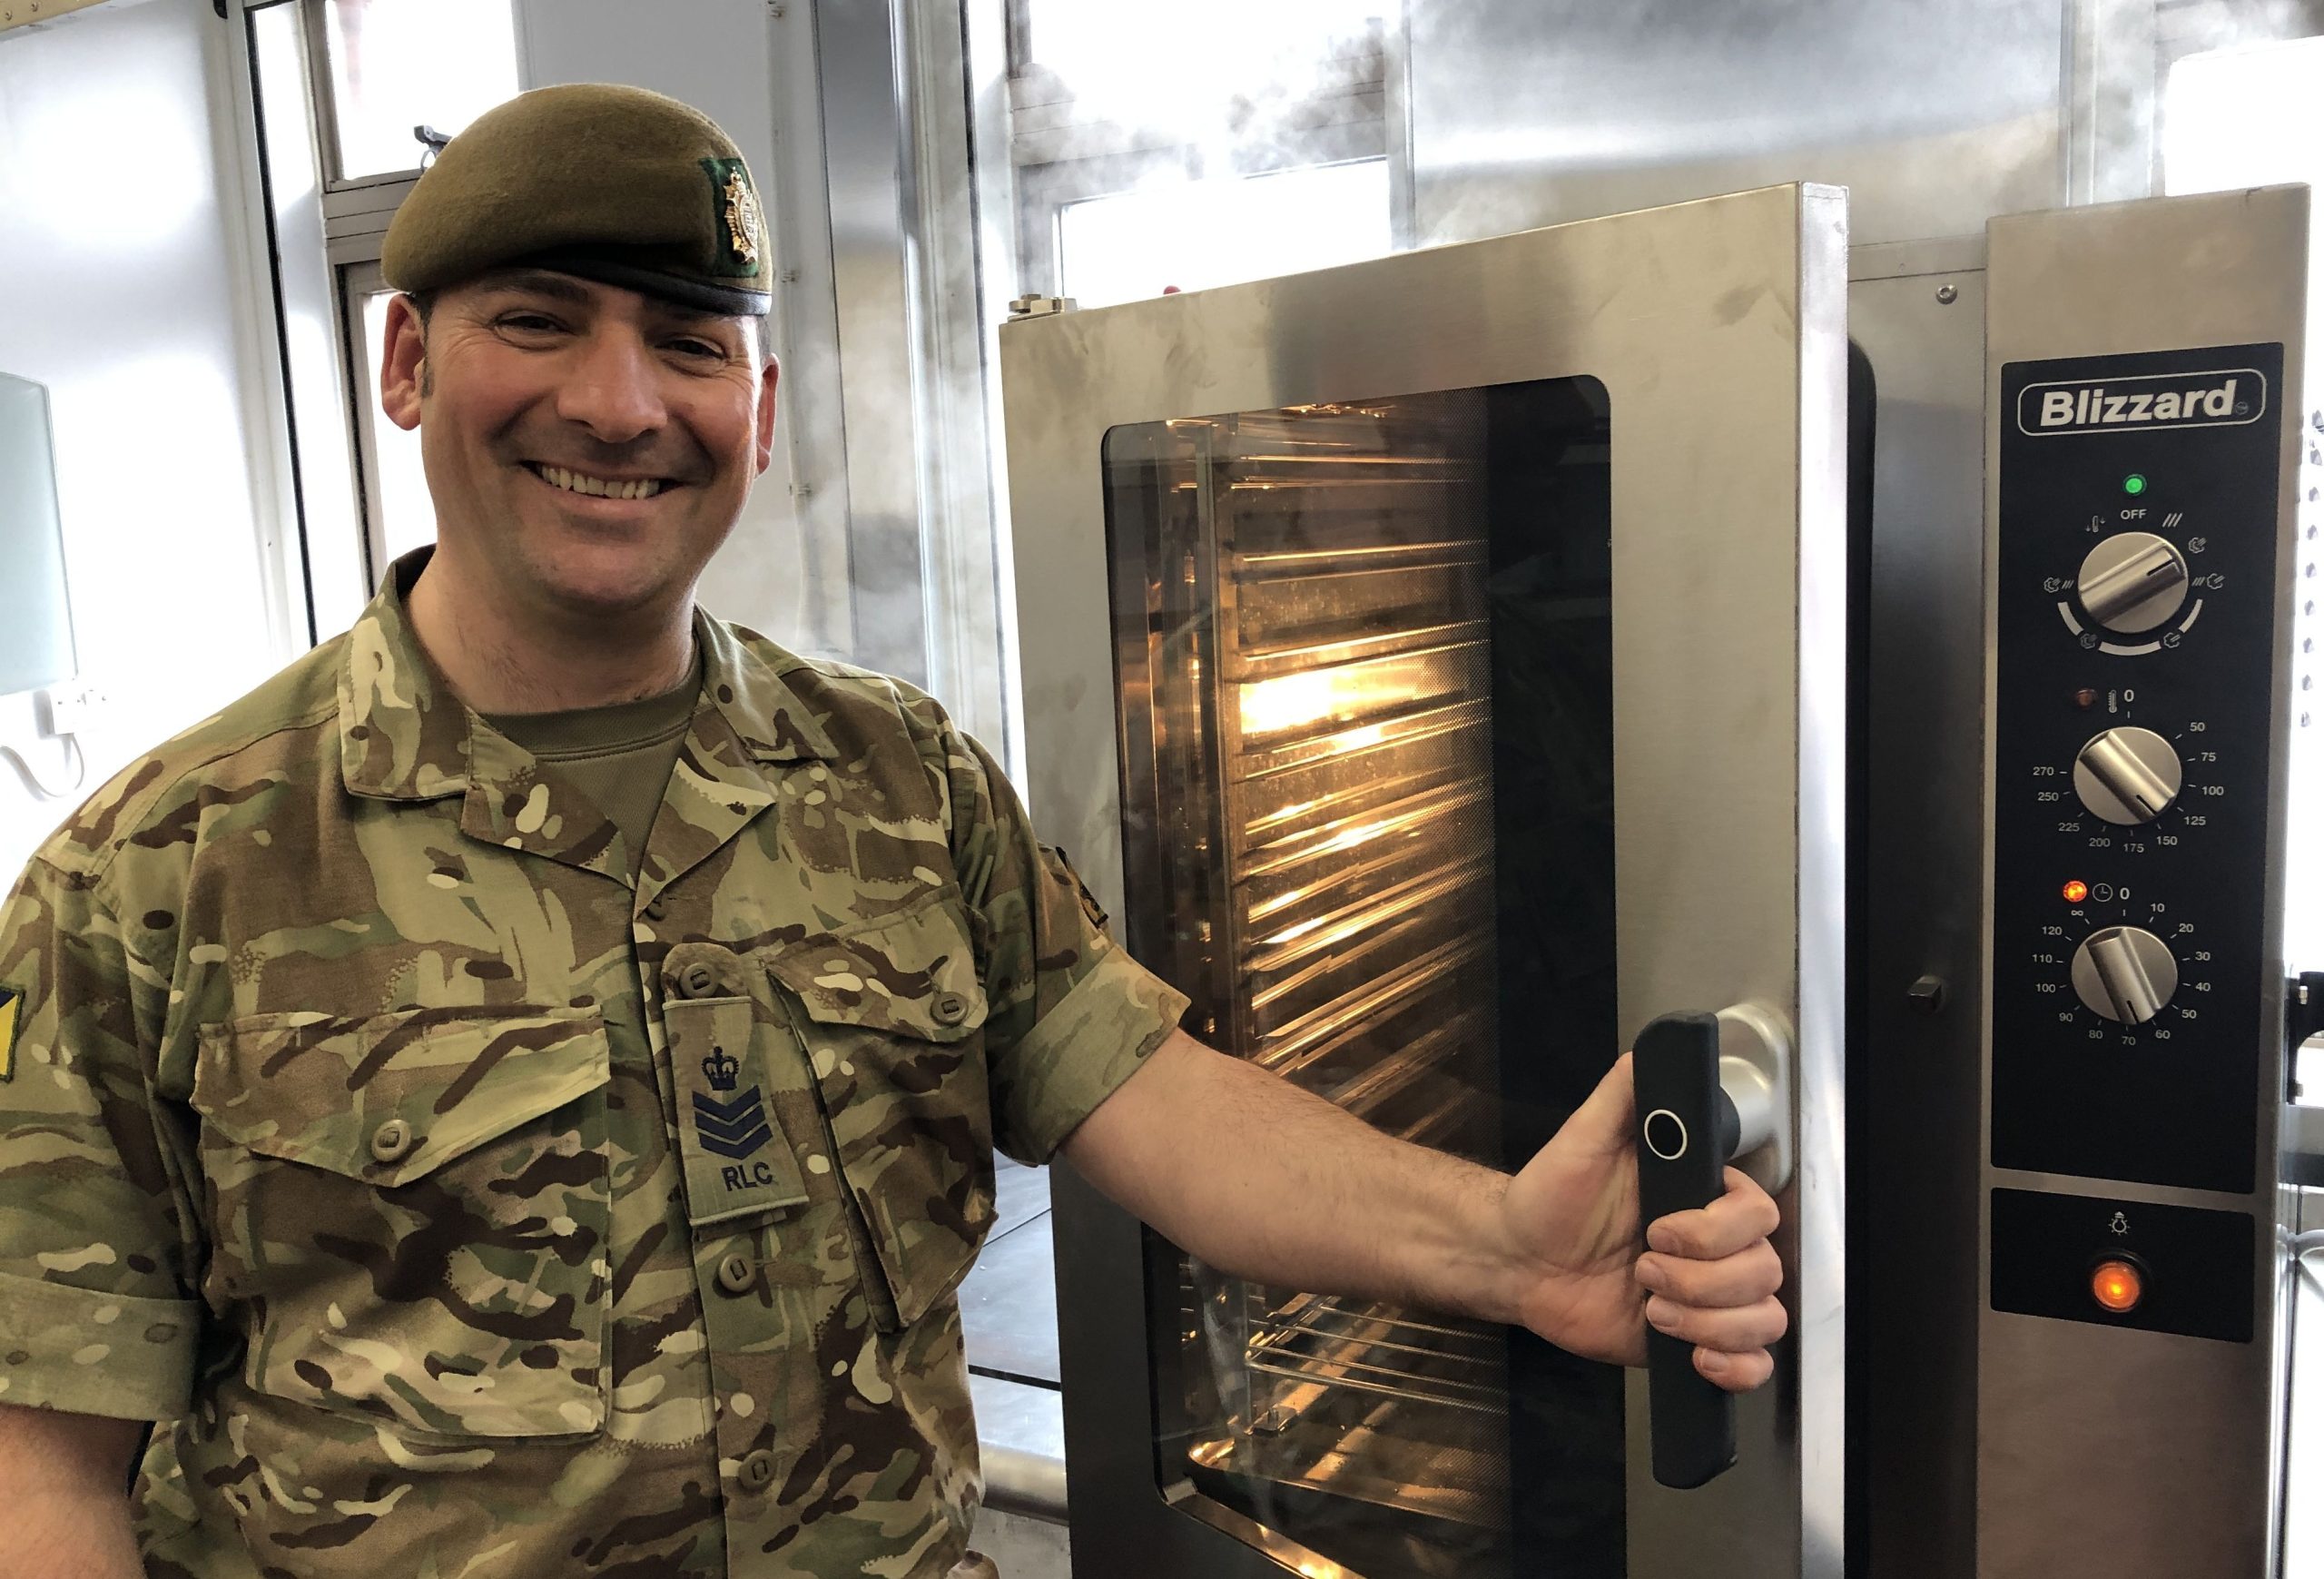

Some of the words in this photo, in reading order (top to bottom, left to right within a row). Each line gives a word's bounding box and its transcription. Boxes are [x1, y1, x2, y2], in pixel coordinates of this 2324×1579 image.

[2040, 380, 2238, 427] Blizzard
[2120, 508, 2147, 520] OFF
[2190, 721, 2206, 732] 50
[2201, 752, 2217, 763] 75
[2033, 765, 2054, 776] 270
[2201, 785, 2225, 796] 100
[2037, 791, 2059, 802] 250
[2183, 815, 2206, 826] 125
[2057, 822, 2081, 833] 225
[2088, 837, 2111, 848] 200
[2156, 835, 2178, 846] 150
[2122, 843, 2145, 854] 175
[2150, 903, 2165, 913] 10
[2042, 925, 2063, 936] 120
[2178, 923, 2194, 933] 20
[2032, 953, 2053, 963] 110
[2194, 951, 2211, 962] 30
[2035, 982, 2056, 993] 100
[2195, 982, 2211, 992] 40
[2058, 1012, 2073, 1022] 90
[2181, 1009, 2198, 1020] 50
[2088, 1029, 2103, 1040] 80
[2154, 1030, 2171, 1040] 60
[2121, 1035, 2136, 1046] 70
[721, 1161, 774, 1191] RLC
